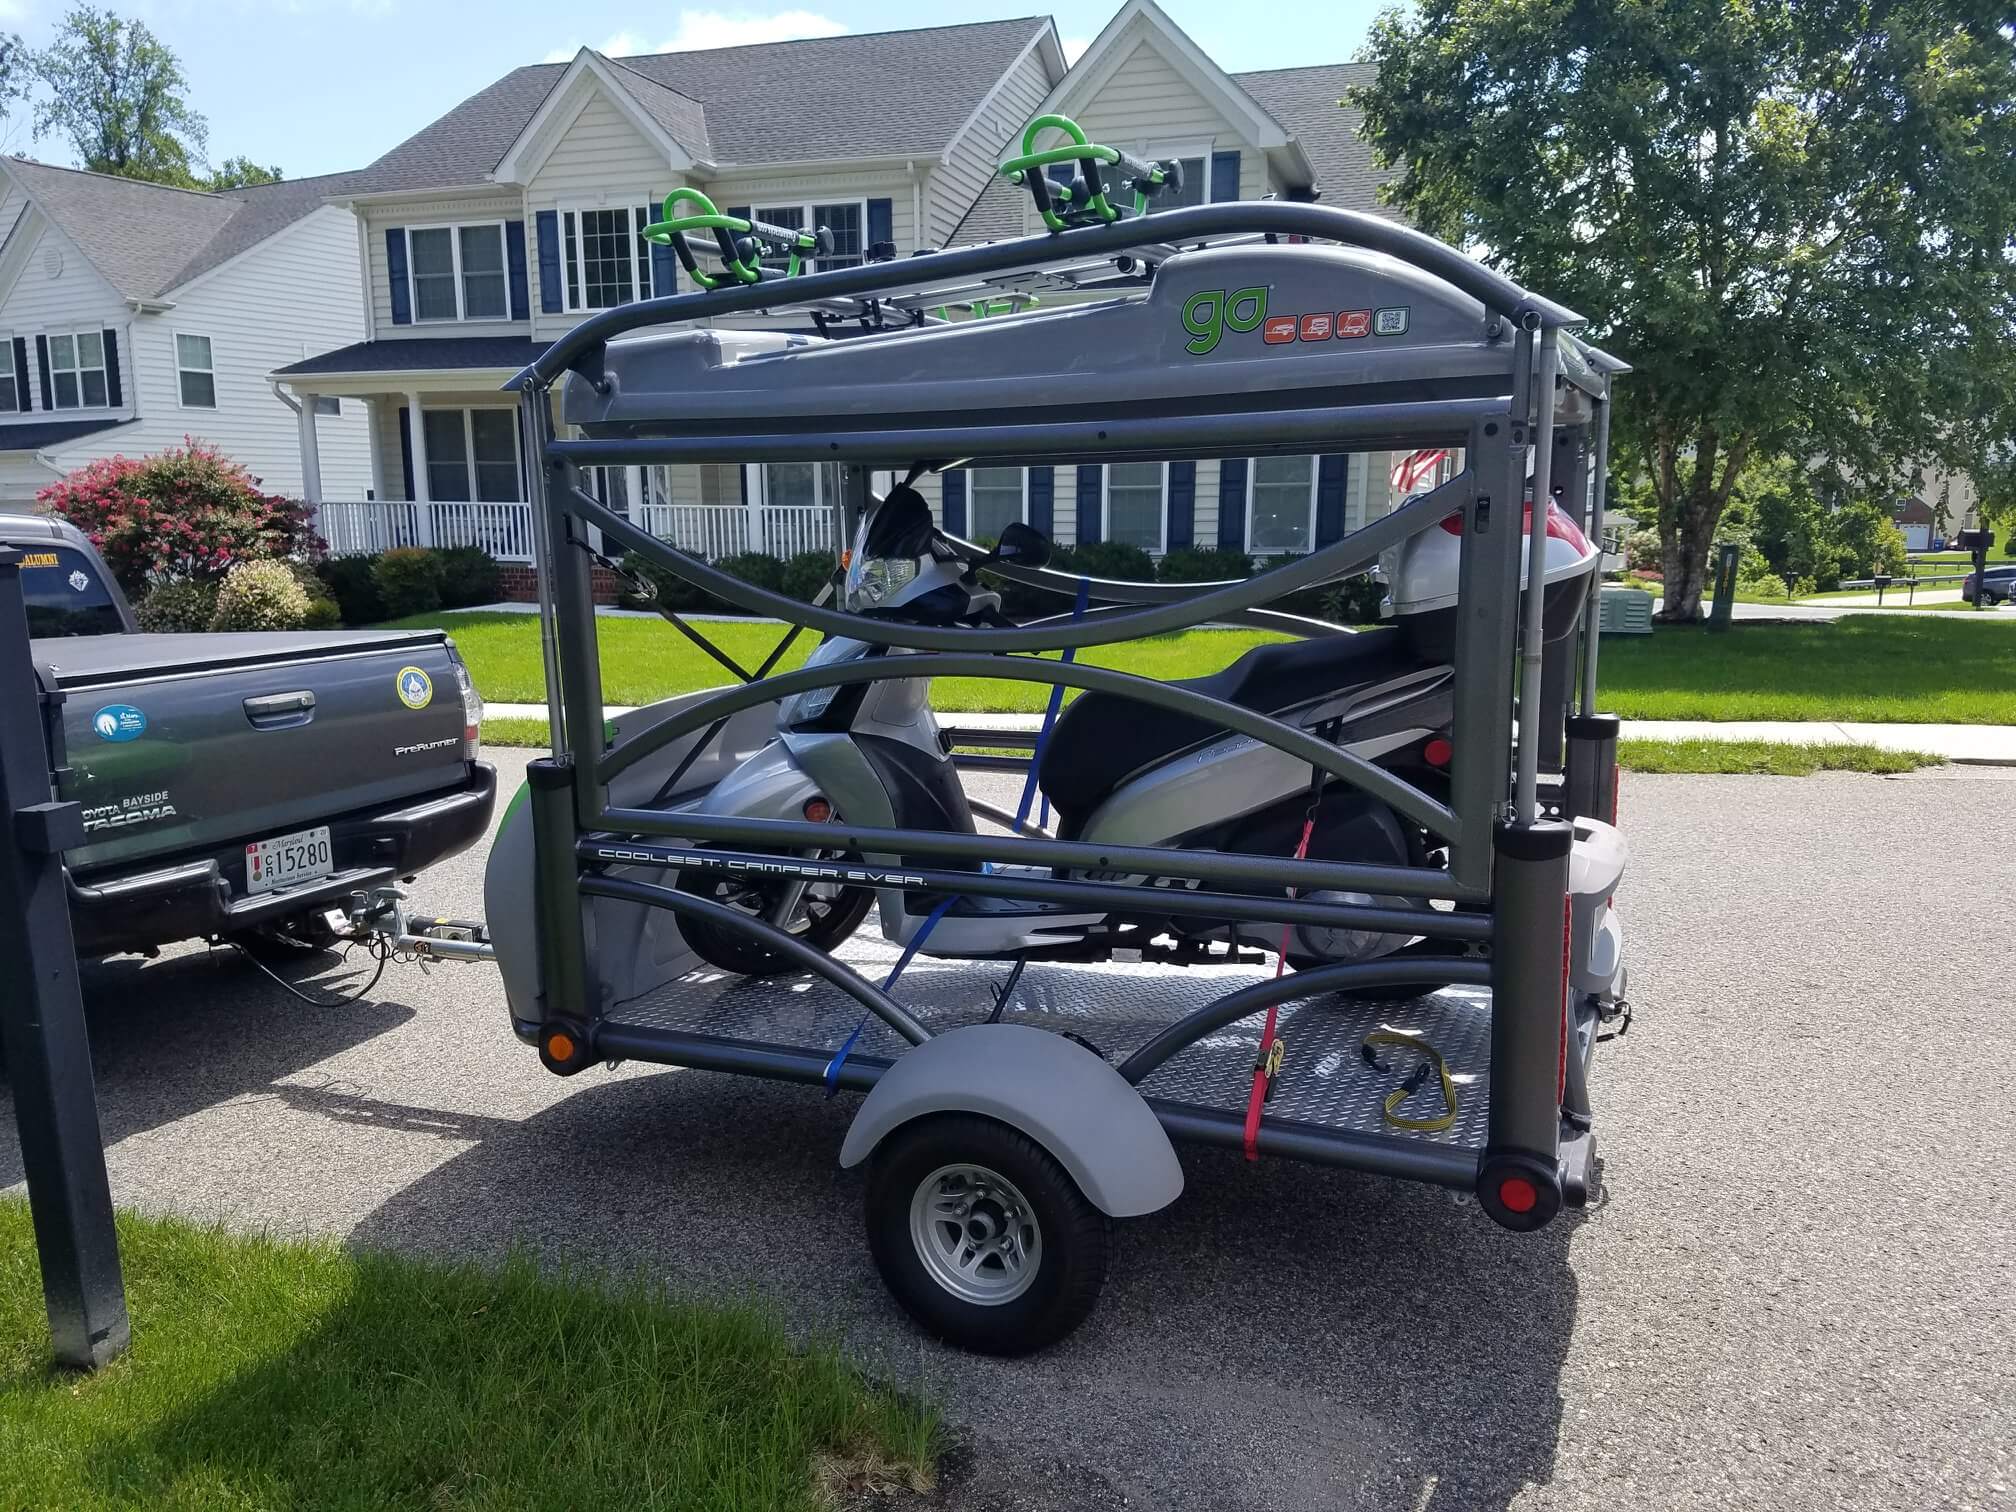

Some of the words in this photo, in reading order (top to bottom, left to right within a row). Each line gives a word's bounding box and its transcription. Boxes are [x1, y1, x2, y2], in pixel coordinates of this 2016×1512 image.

[1181, 286, 1270, 355] go
[81, 804, 121, 820] OYOTA
[123, 791, 169, 808] BAYSIDE
[83, 805, 177, 832] TACOMA
[598, 848, 722, 868] COOLEST.
[728, 860, 843, 879] CAMPER.
[847, 870, 929, 887] EVER.
